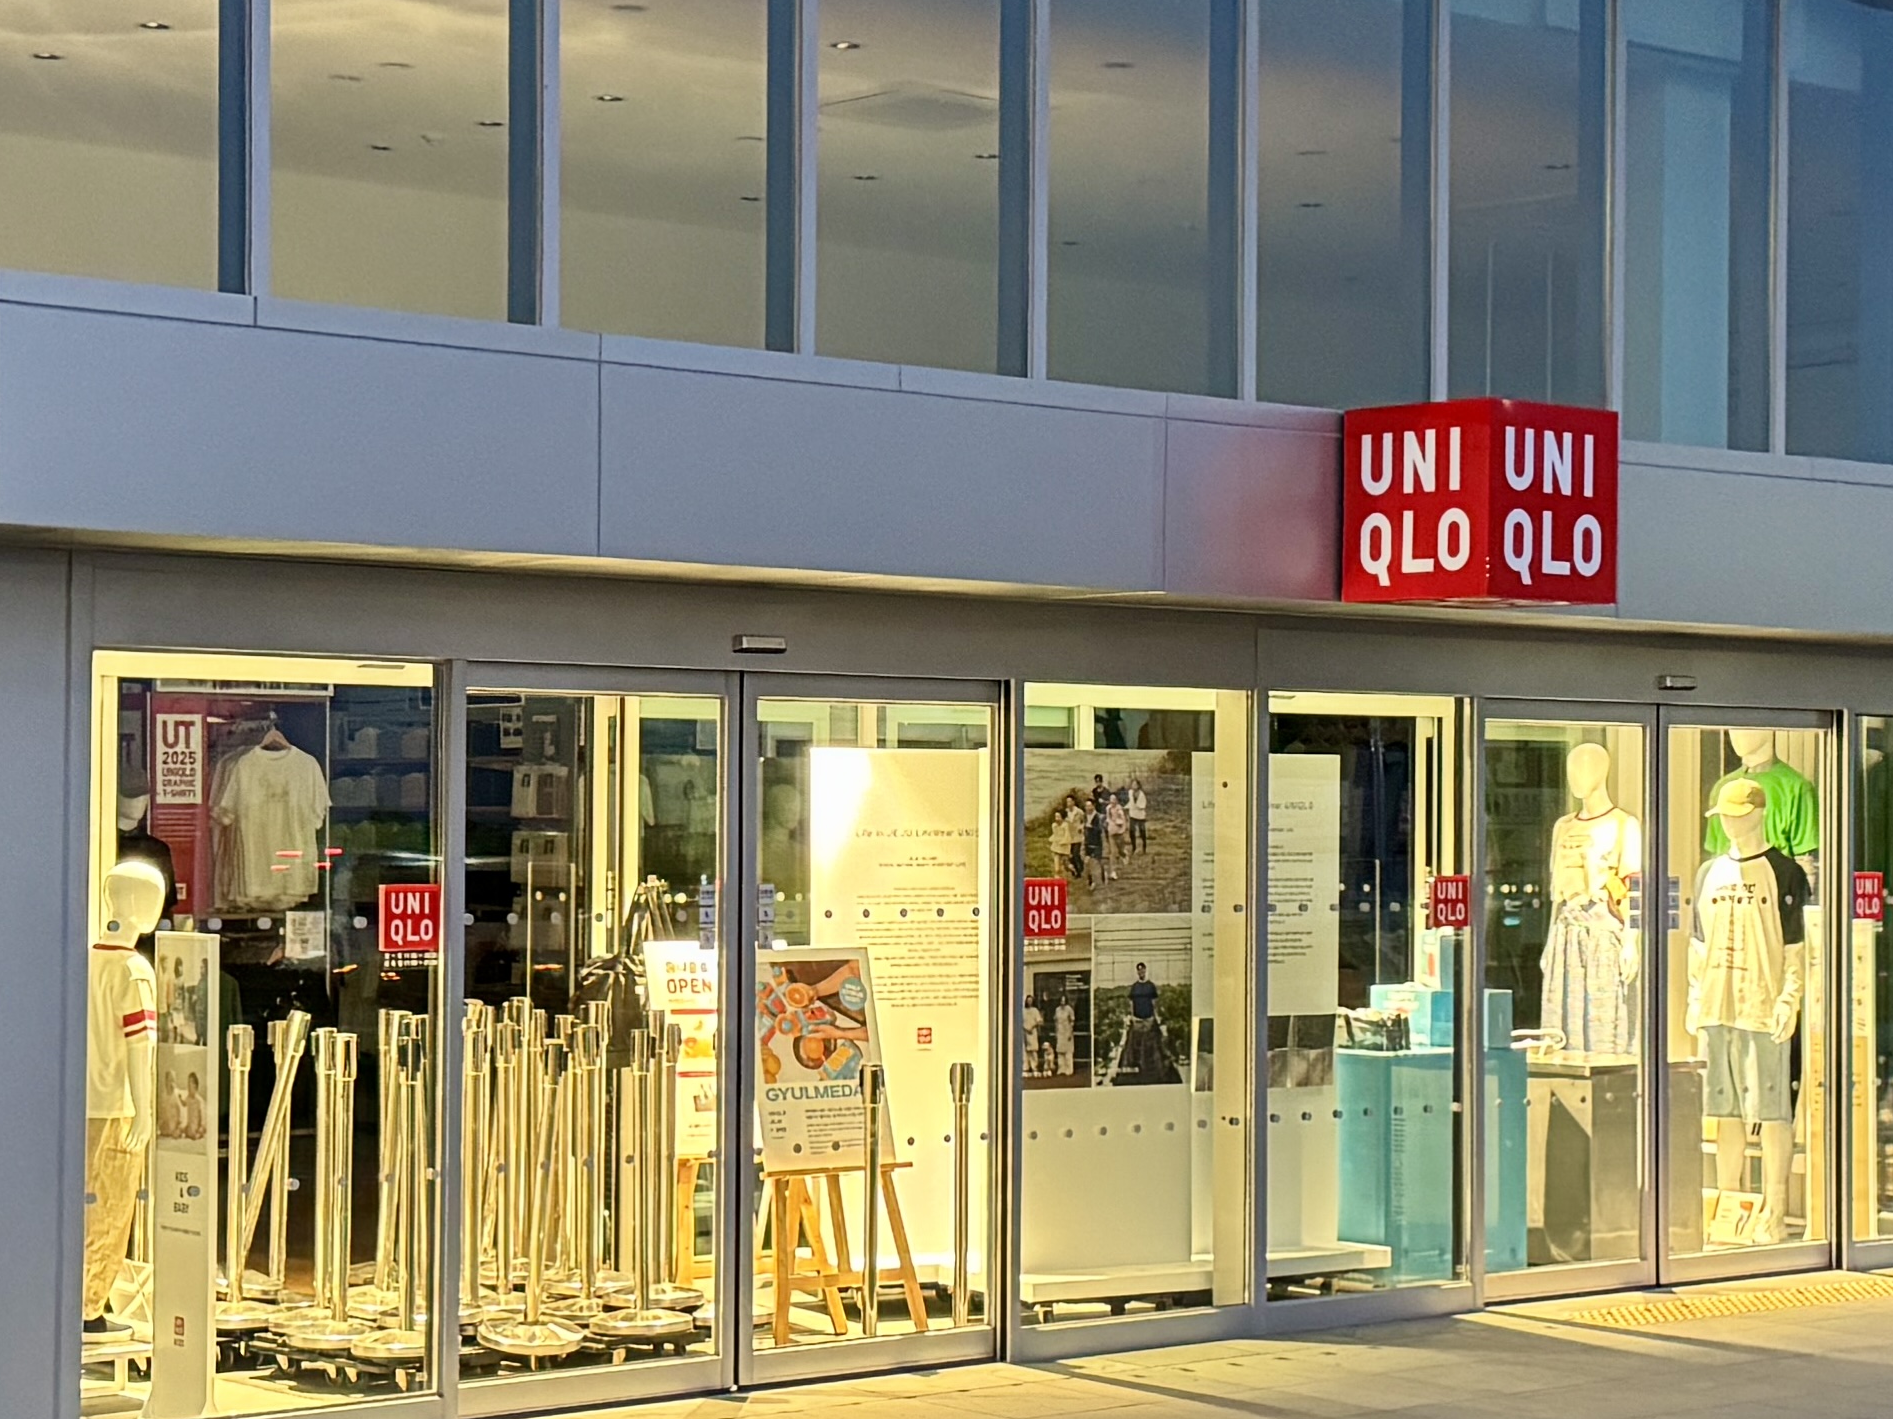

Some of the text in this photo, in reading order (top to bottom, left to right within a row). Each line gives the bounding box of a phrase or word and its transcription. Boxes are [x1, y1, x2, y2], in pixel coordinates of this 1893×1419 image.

[1361, 427, 1460, 495] UNI
[1505, 426, 1594, 497] UNI
[1360, 507, 1470, 587] QLO
[1504, 508, 1602, 585] QLO
[162, 719, 195, 750] UT
[162, 751, 196, 766] 2025
[1028, 885, 1059, 906] UNI
[1437, 881, 1463, 900] UNI
[1856, 878, 1878, 895] UNI
[391, 892, 429, 914] UNI
[1437, 903, 1465, 924] QLO
[1856, 897, 1880, 917] QLO
[1028, 909, 1061, 933] QLO
[390, 919, 433, 946] QLO
[667, 978, 713, 995] OPEN
